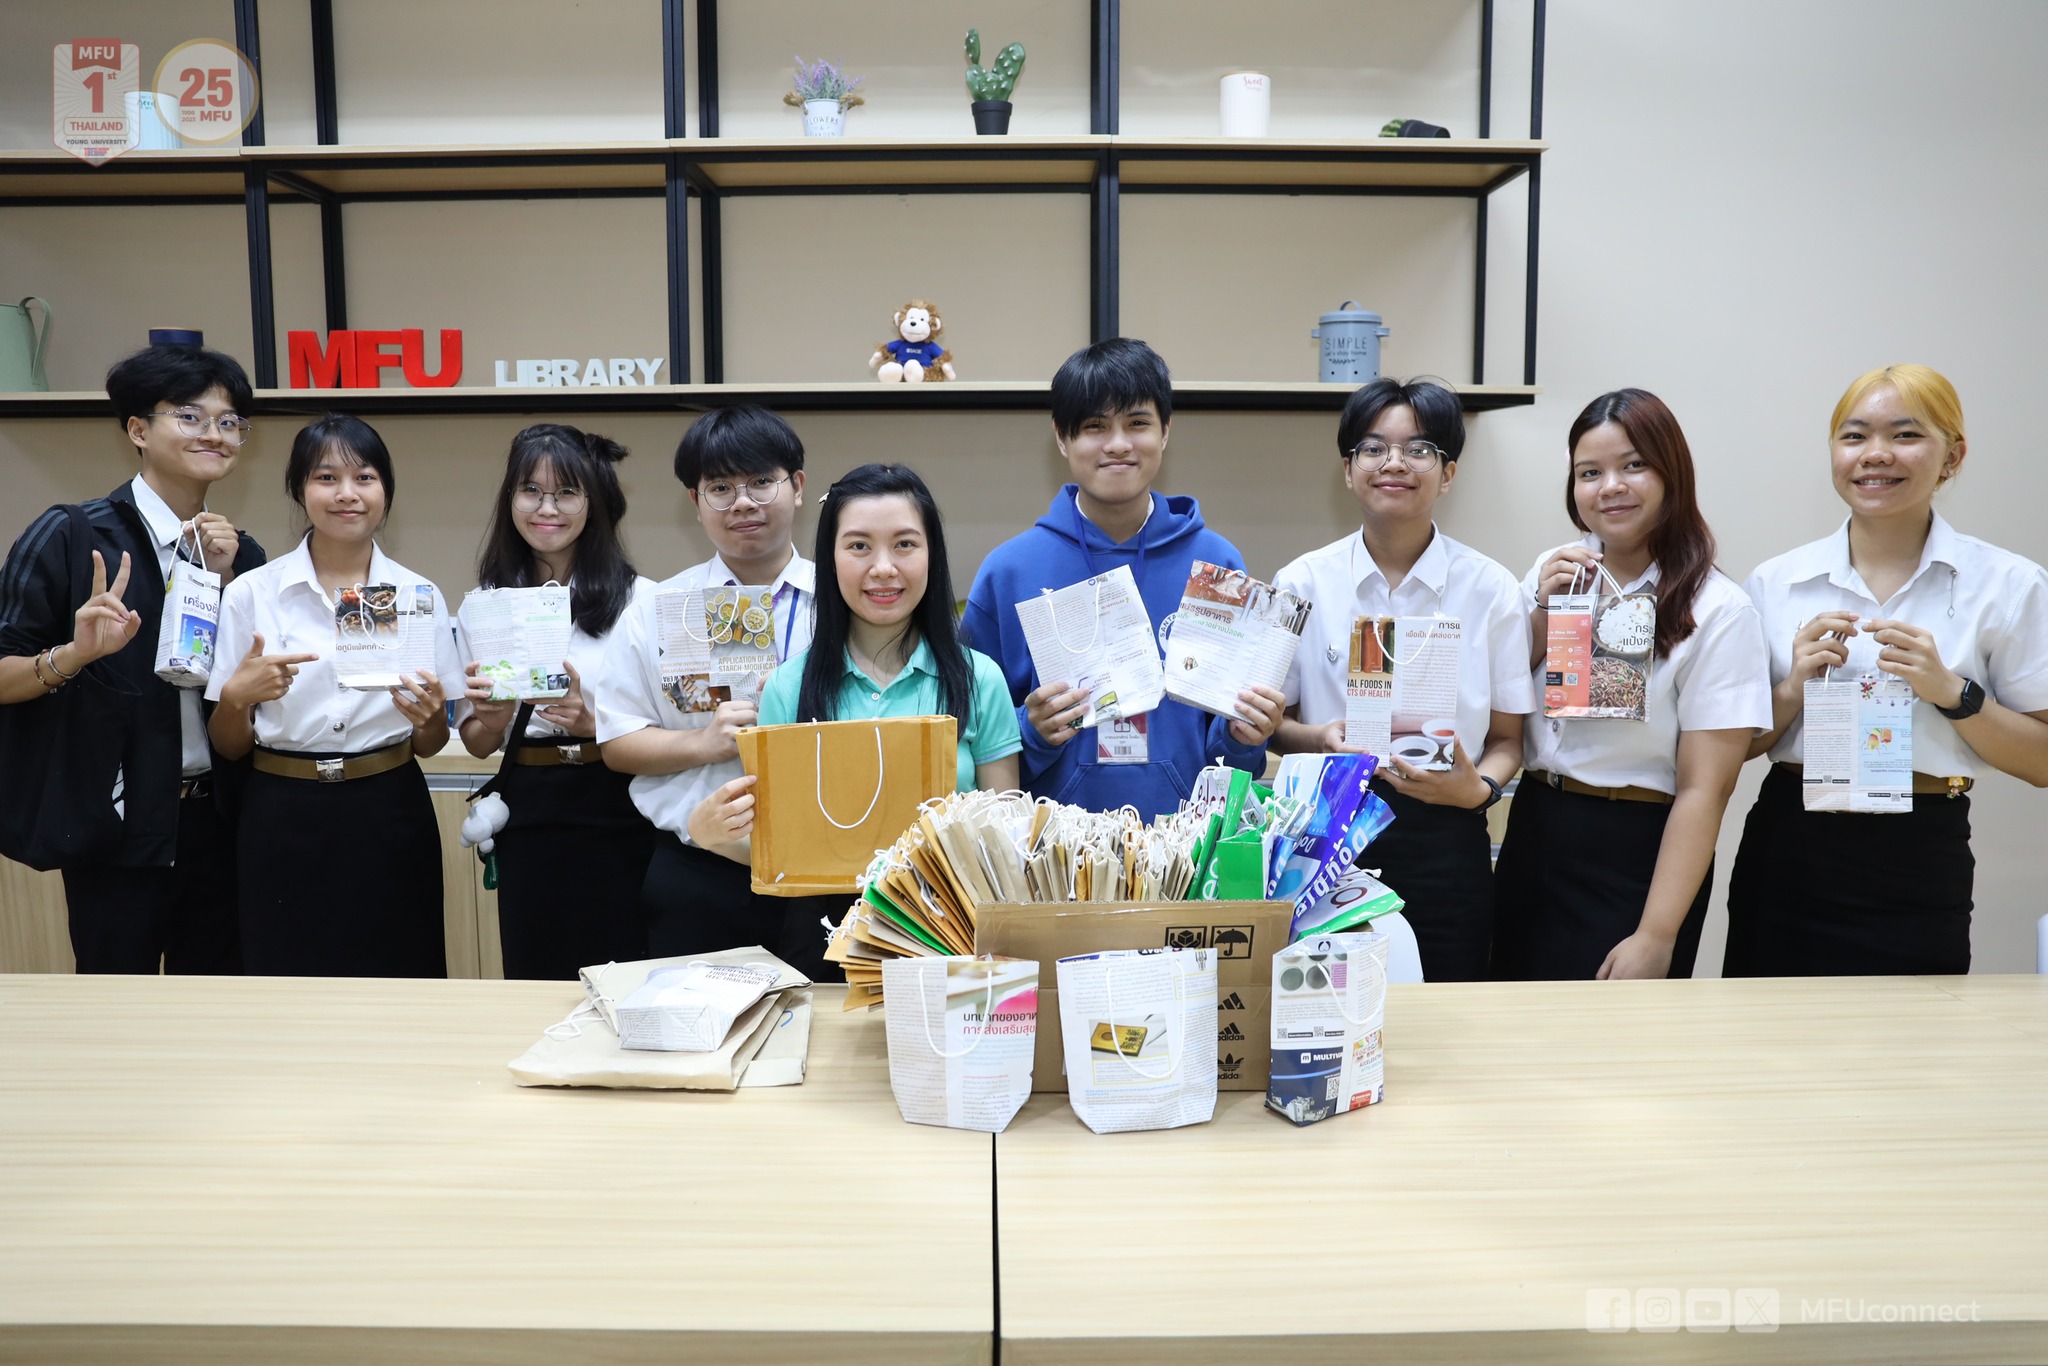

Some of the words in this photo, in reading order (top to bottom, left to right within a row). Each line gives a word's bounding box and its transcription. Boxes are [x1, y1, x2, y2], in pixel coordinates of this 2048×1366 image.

[1324, 336, 1367, 350] SIMPLE
[287, 328, 463, 389] MFU
[494, 357, 665, 388] LIBRARY
[1360, 679, 1383, 690] FOODS
[1384, 680, 1392, 690] IN
[1359, 689, 1368, 697] OF
[1368, 690, 1391, 698] HEALTH
